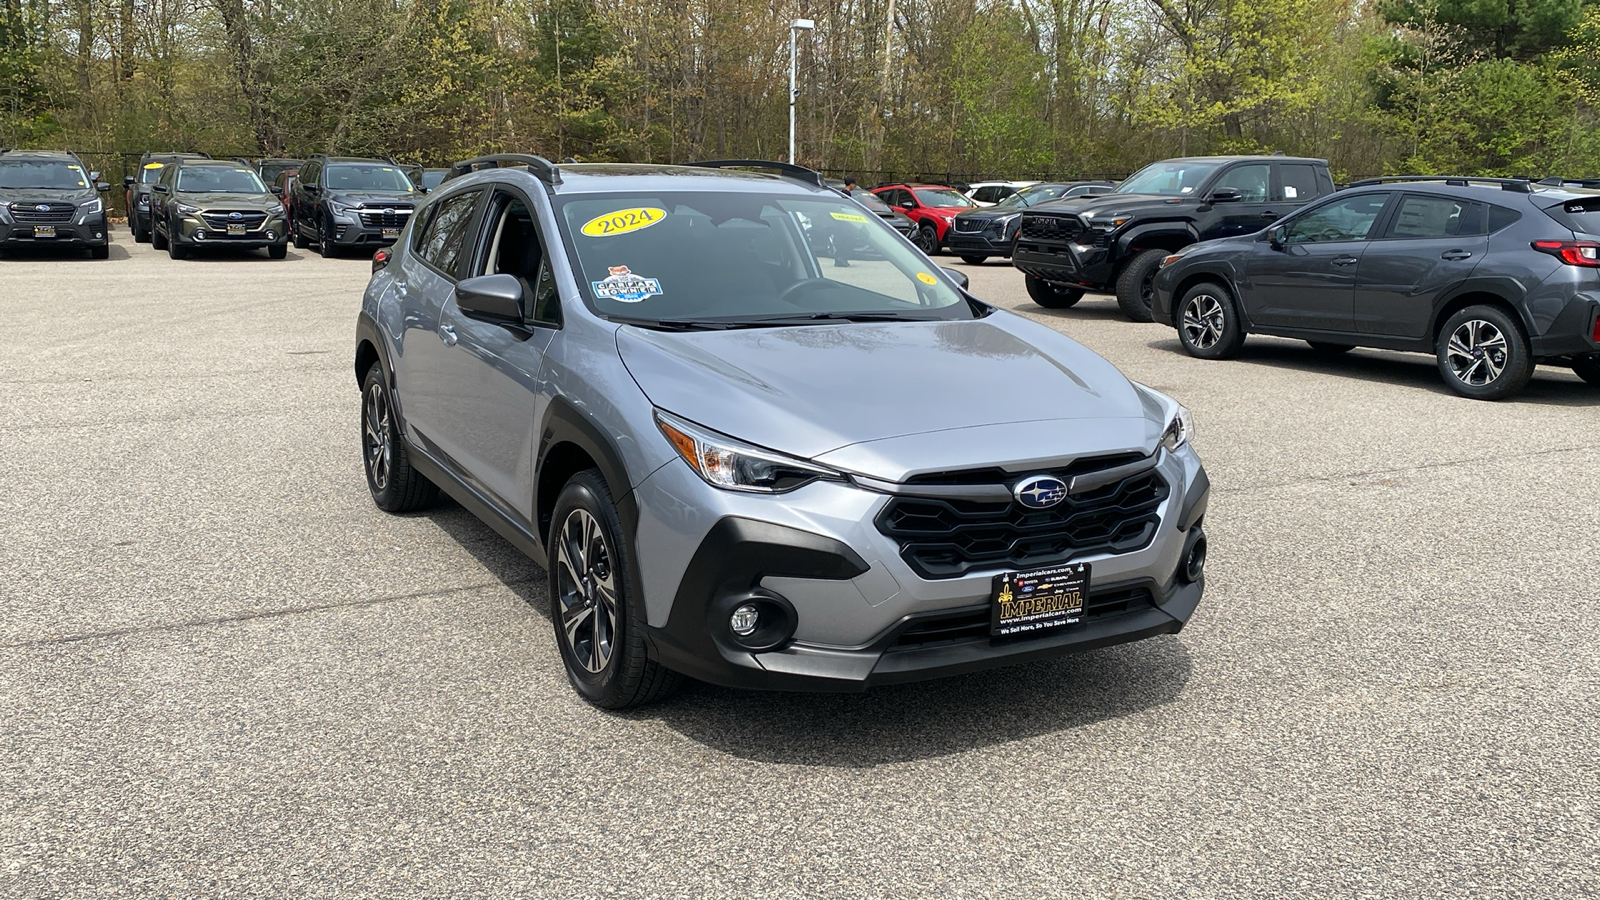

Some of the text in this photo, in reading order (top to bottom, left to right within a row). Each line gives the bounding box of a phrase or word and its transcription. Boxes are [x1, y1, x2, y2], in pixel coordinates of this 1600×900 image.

[597, 209, 654, 233] 2024
[597, 281, 655, 290] CARFAX
[609, 287, 658, 295] OWNER
[1016, 567, 1071, 579] Imperialcars.com
[1001, 592, 1083, 619] IMPERIAL
[1000, 607, 1082, 625] www.imperialcars.com
